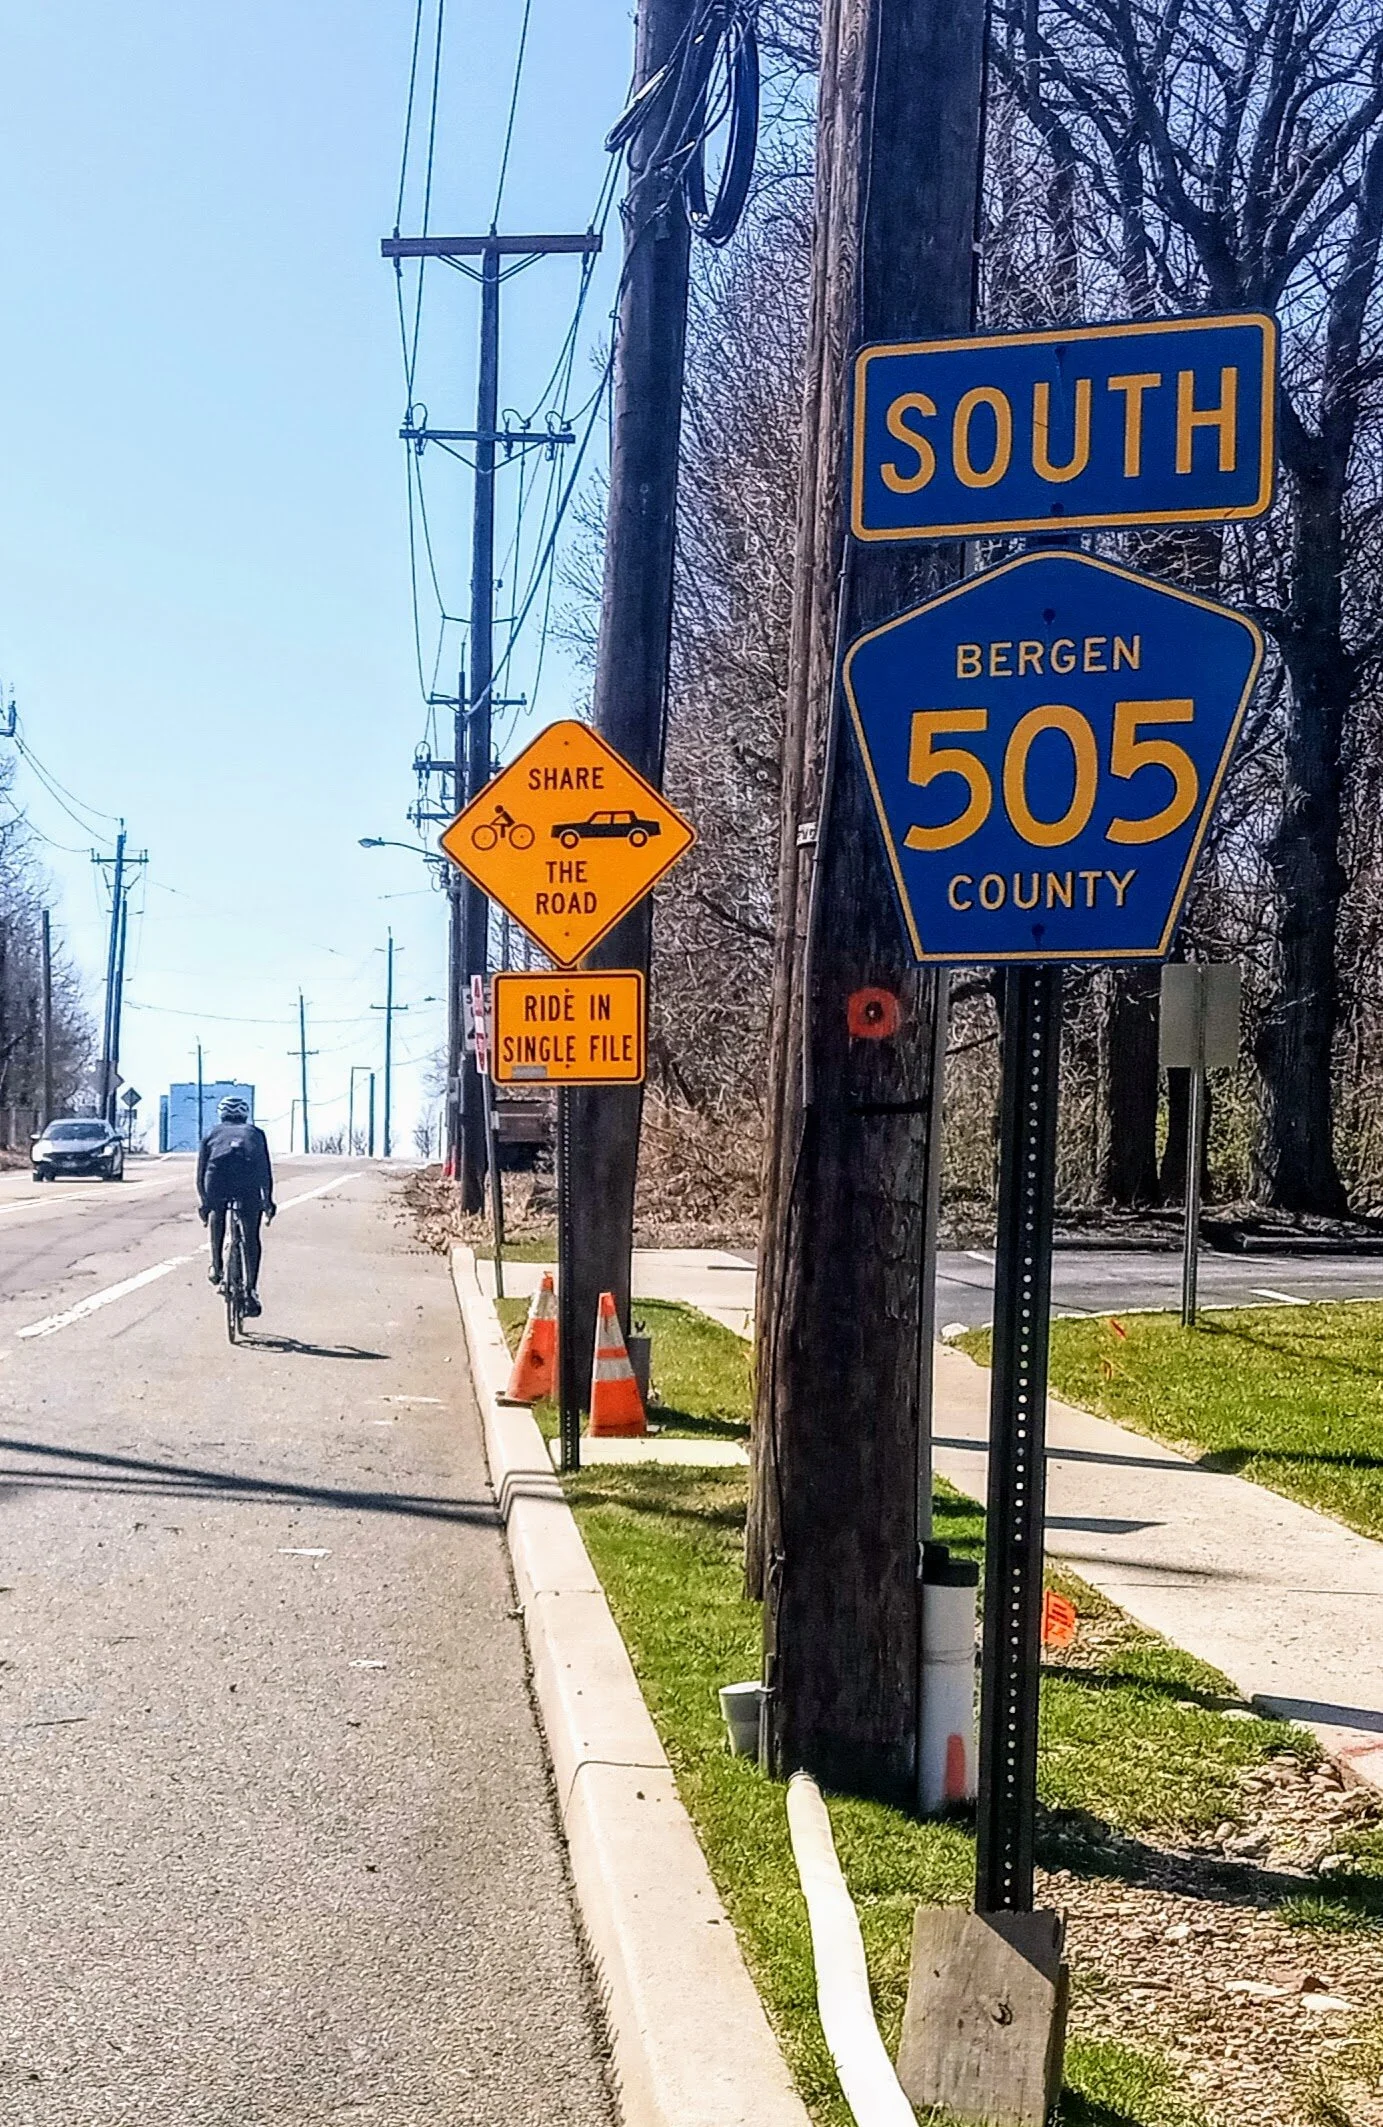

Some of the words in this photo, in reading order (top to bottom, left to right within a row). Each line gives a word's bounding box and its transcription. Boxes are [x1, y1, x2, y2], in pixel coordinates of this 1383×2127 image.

[880, 366, 1238, 494] SOUTH
[956, 635, 1140, 679] BERGEN
[528, 766, 605, 791] SHARE
[903, 698, 1199, 852] 505
[545, 860, 588, 884] THE
[536, 891, 598, 915] ROAD
[948, 869, 1136, 911] COUNTY
[524, 994, 575, 1022] RIDE
[590, 993, 611, 1021] IN
[502, 1035, 577, 1063] SINGLE
[589, 1034, 633, 1062] FILE
